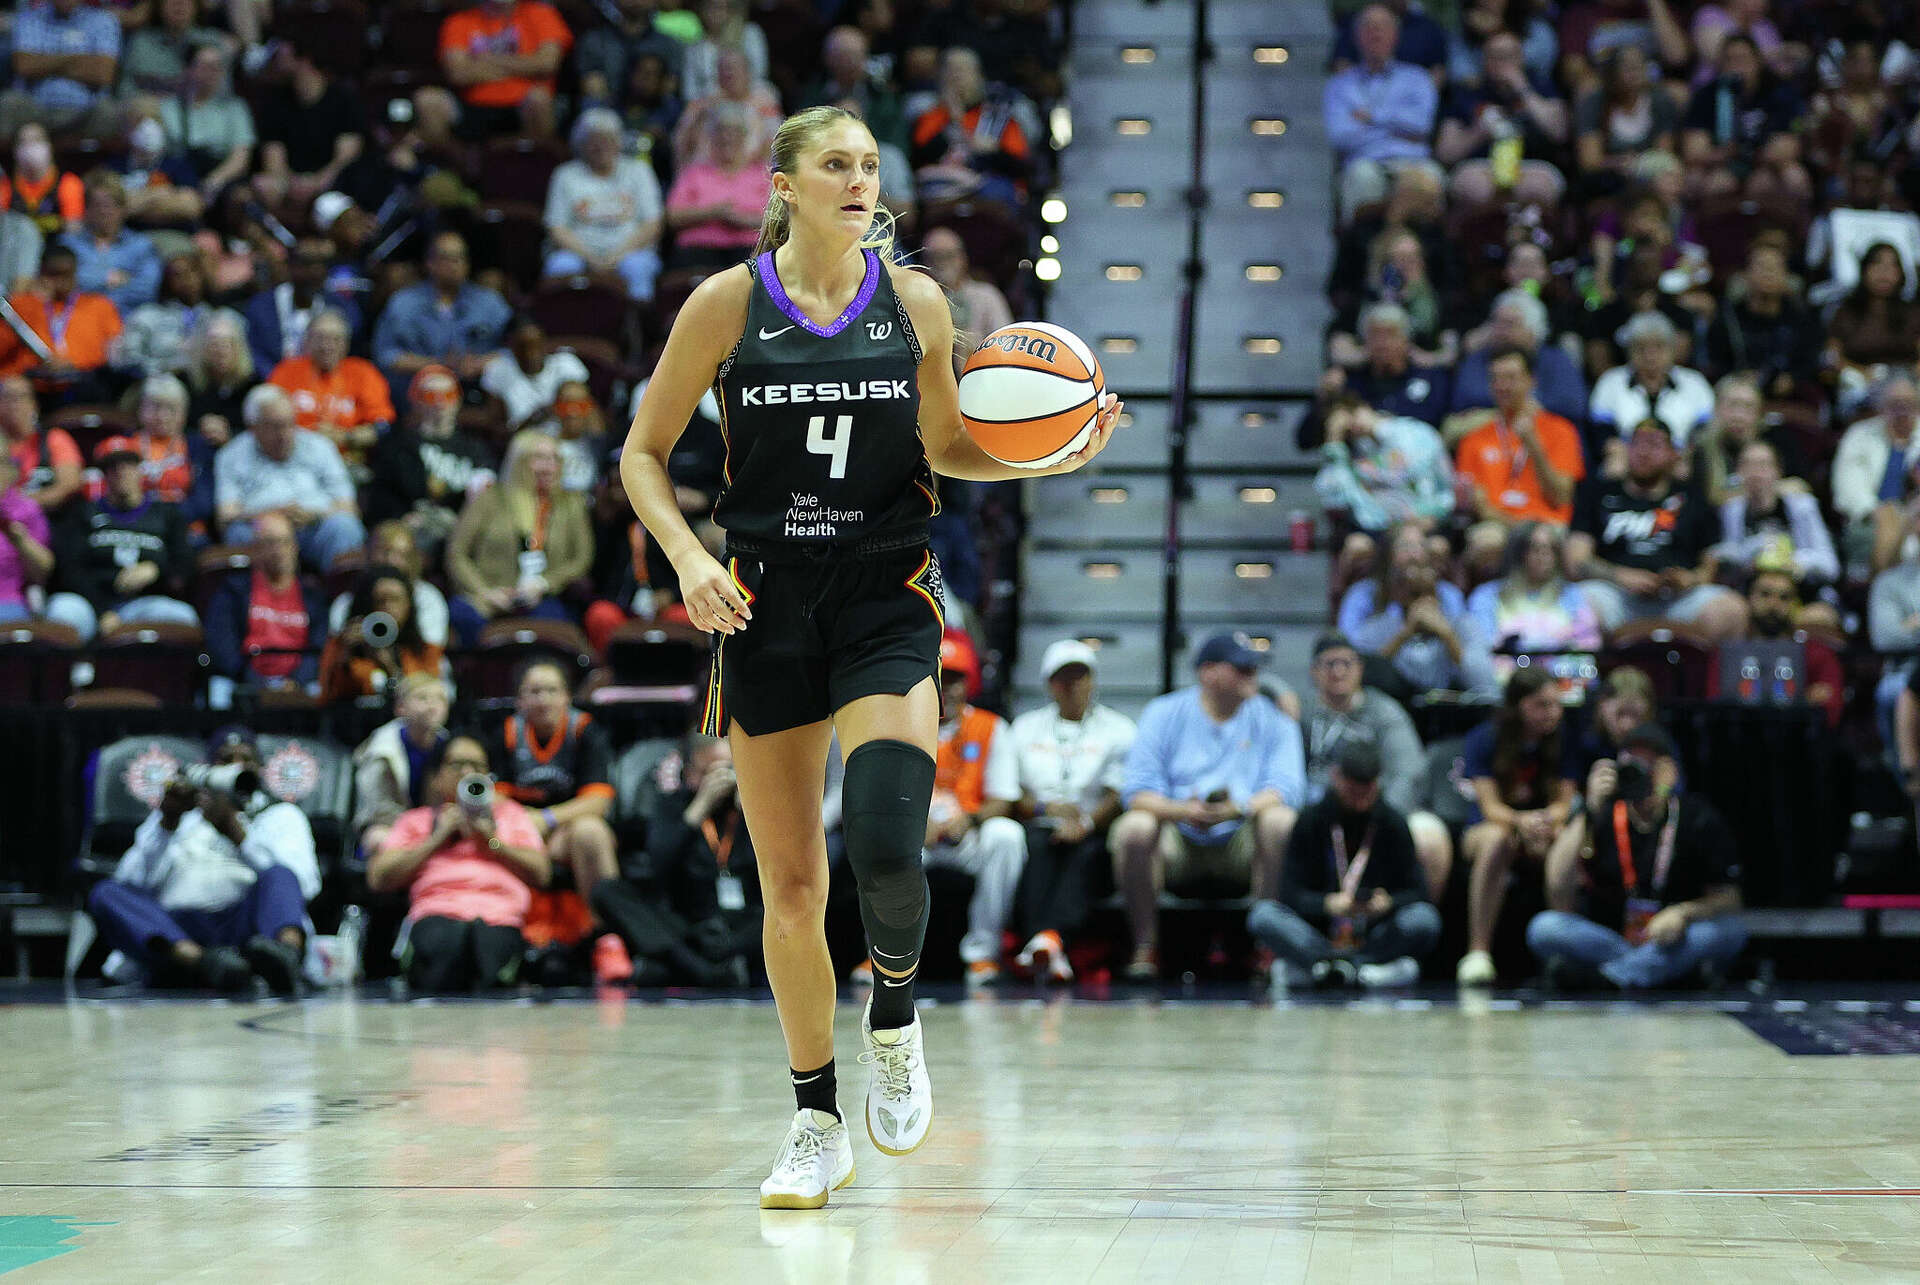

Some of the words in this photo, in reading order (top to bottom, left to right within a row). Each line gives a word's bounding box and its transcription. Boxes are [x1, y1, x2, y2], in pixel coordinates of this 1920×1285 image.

[742, 379, 911, 407] KEESUSK
[806, 414, 854, 479] 4
[791, 492, 818, 507] Yale
[784, 521, 836, 537] Health
